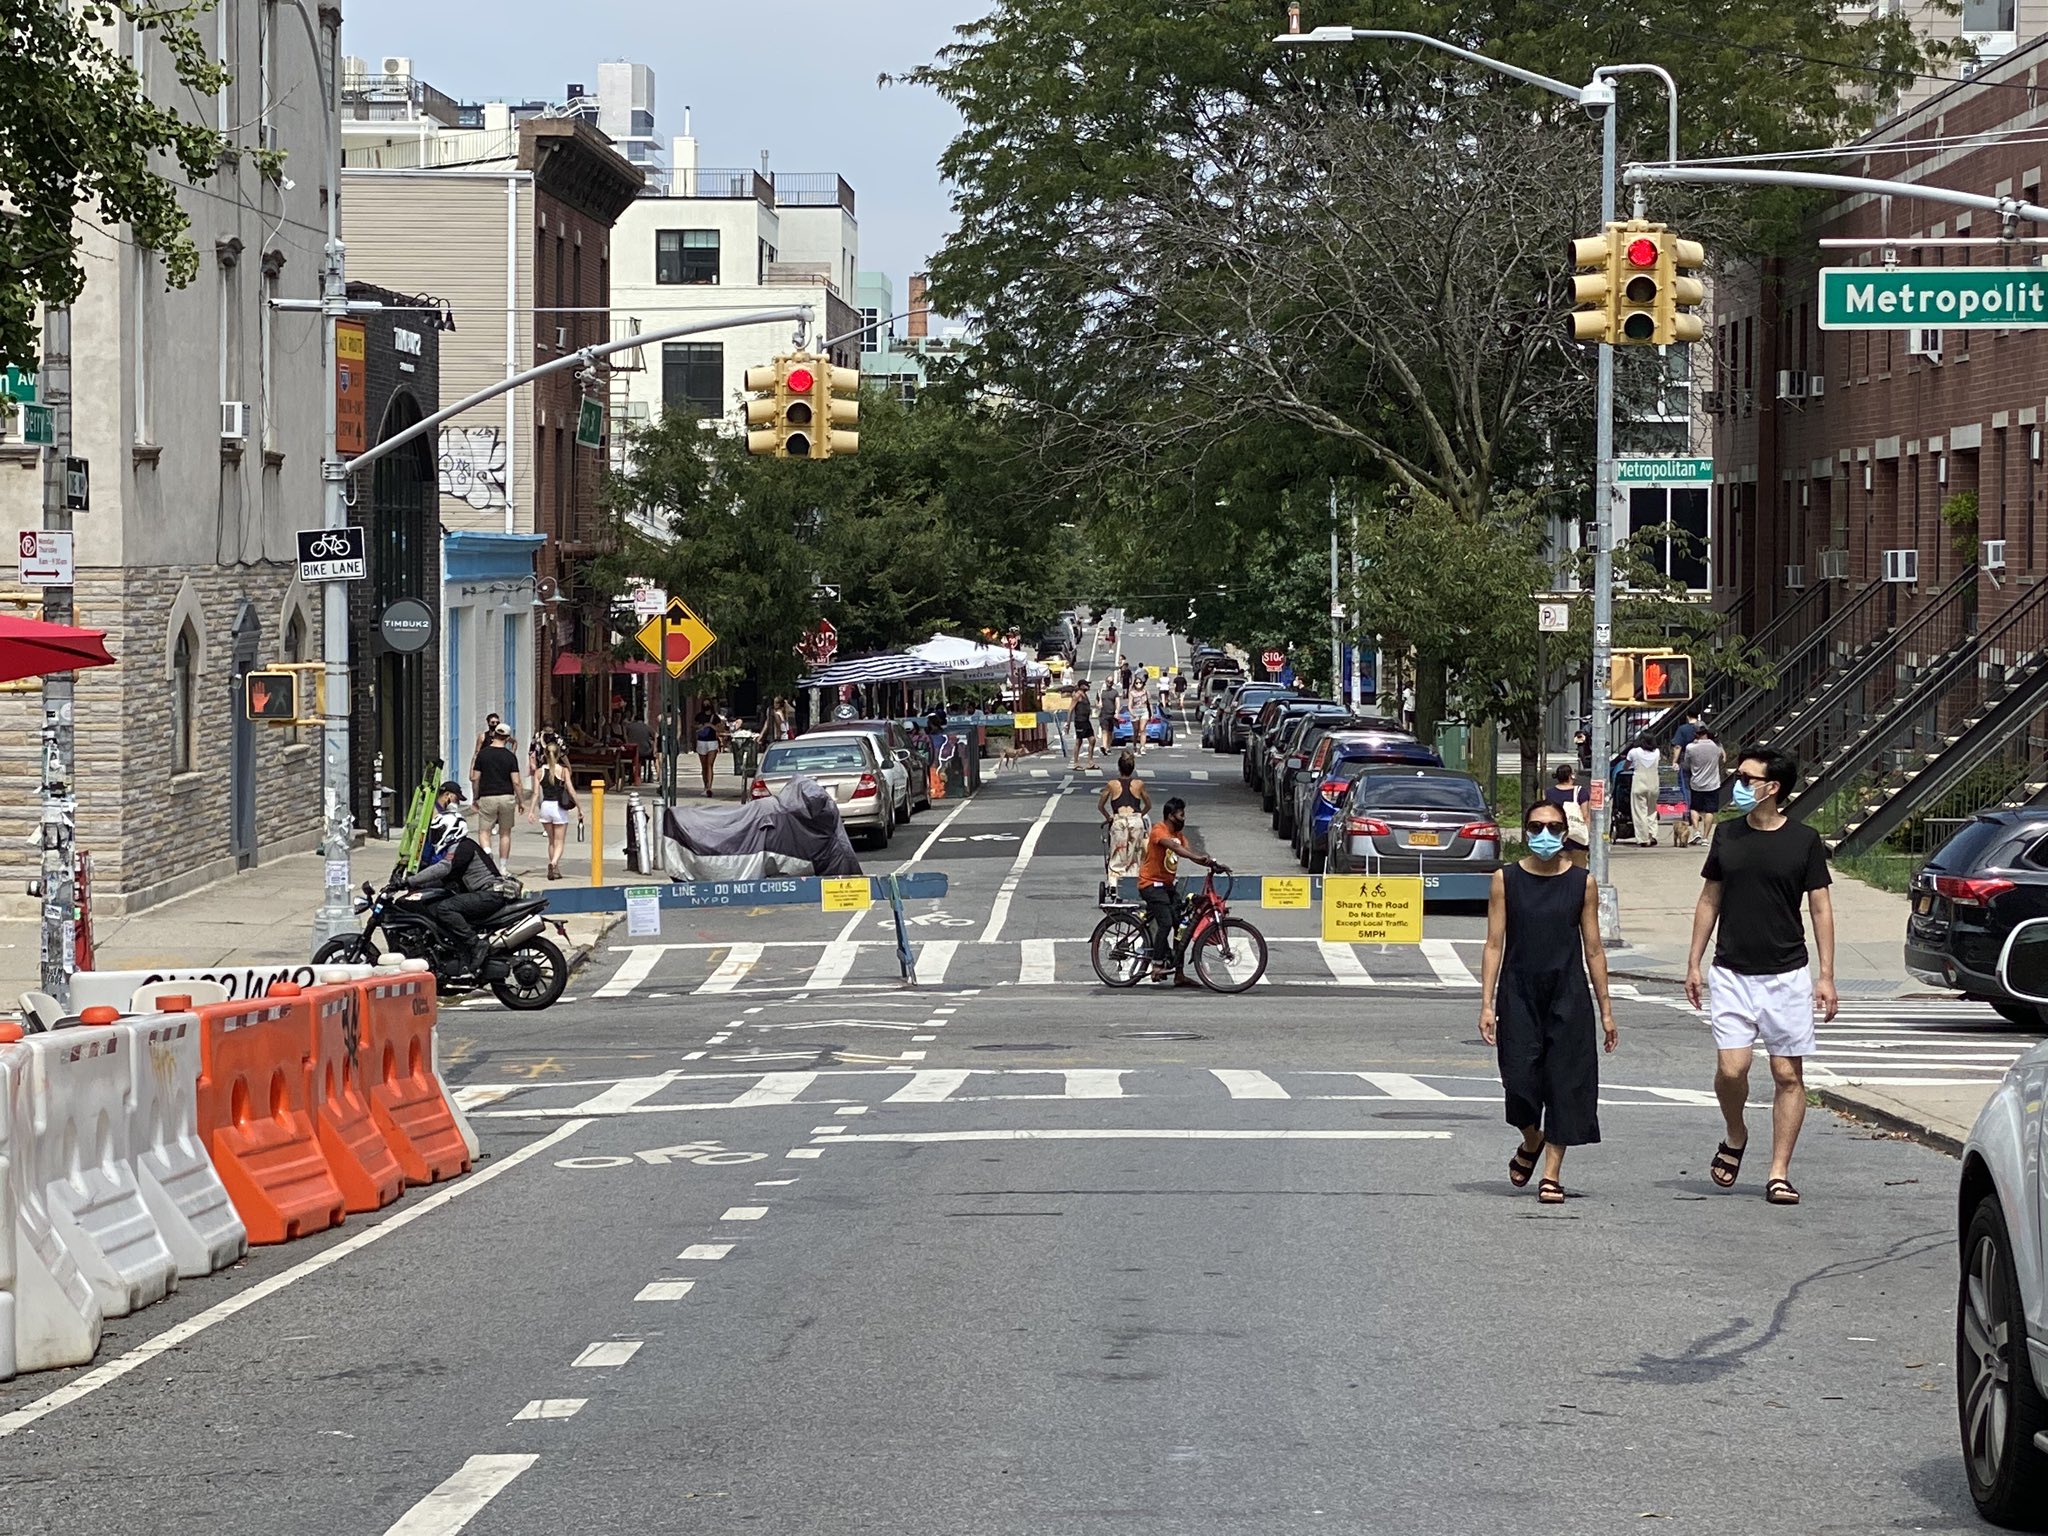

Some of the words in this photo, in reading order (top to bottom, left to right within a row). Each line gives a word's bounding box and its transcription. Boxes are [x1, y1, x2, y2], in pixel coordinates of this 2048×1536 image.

[1617, 460, 1696, 481] Metropolitan
[303, 562, 327, 577] BIKE
[332, 560, 361, 575] LANE
[384, 620, 429, 628] TIMBUK2
[672, 885, 697, 897] LINE
[714, 884, 729, 895] DO
[733, 883, 755, 894] NOT
[759, 881, 797, 893] CROSS
[691, 897, 730, 905] NYPD
[1336, 901, 1362, 909] Share
[1366, 901, 1382, 909] The
[1386, 901, 1409, 909] Road
[1358, 930, 1386, 938] 5MPH
